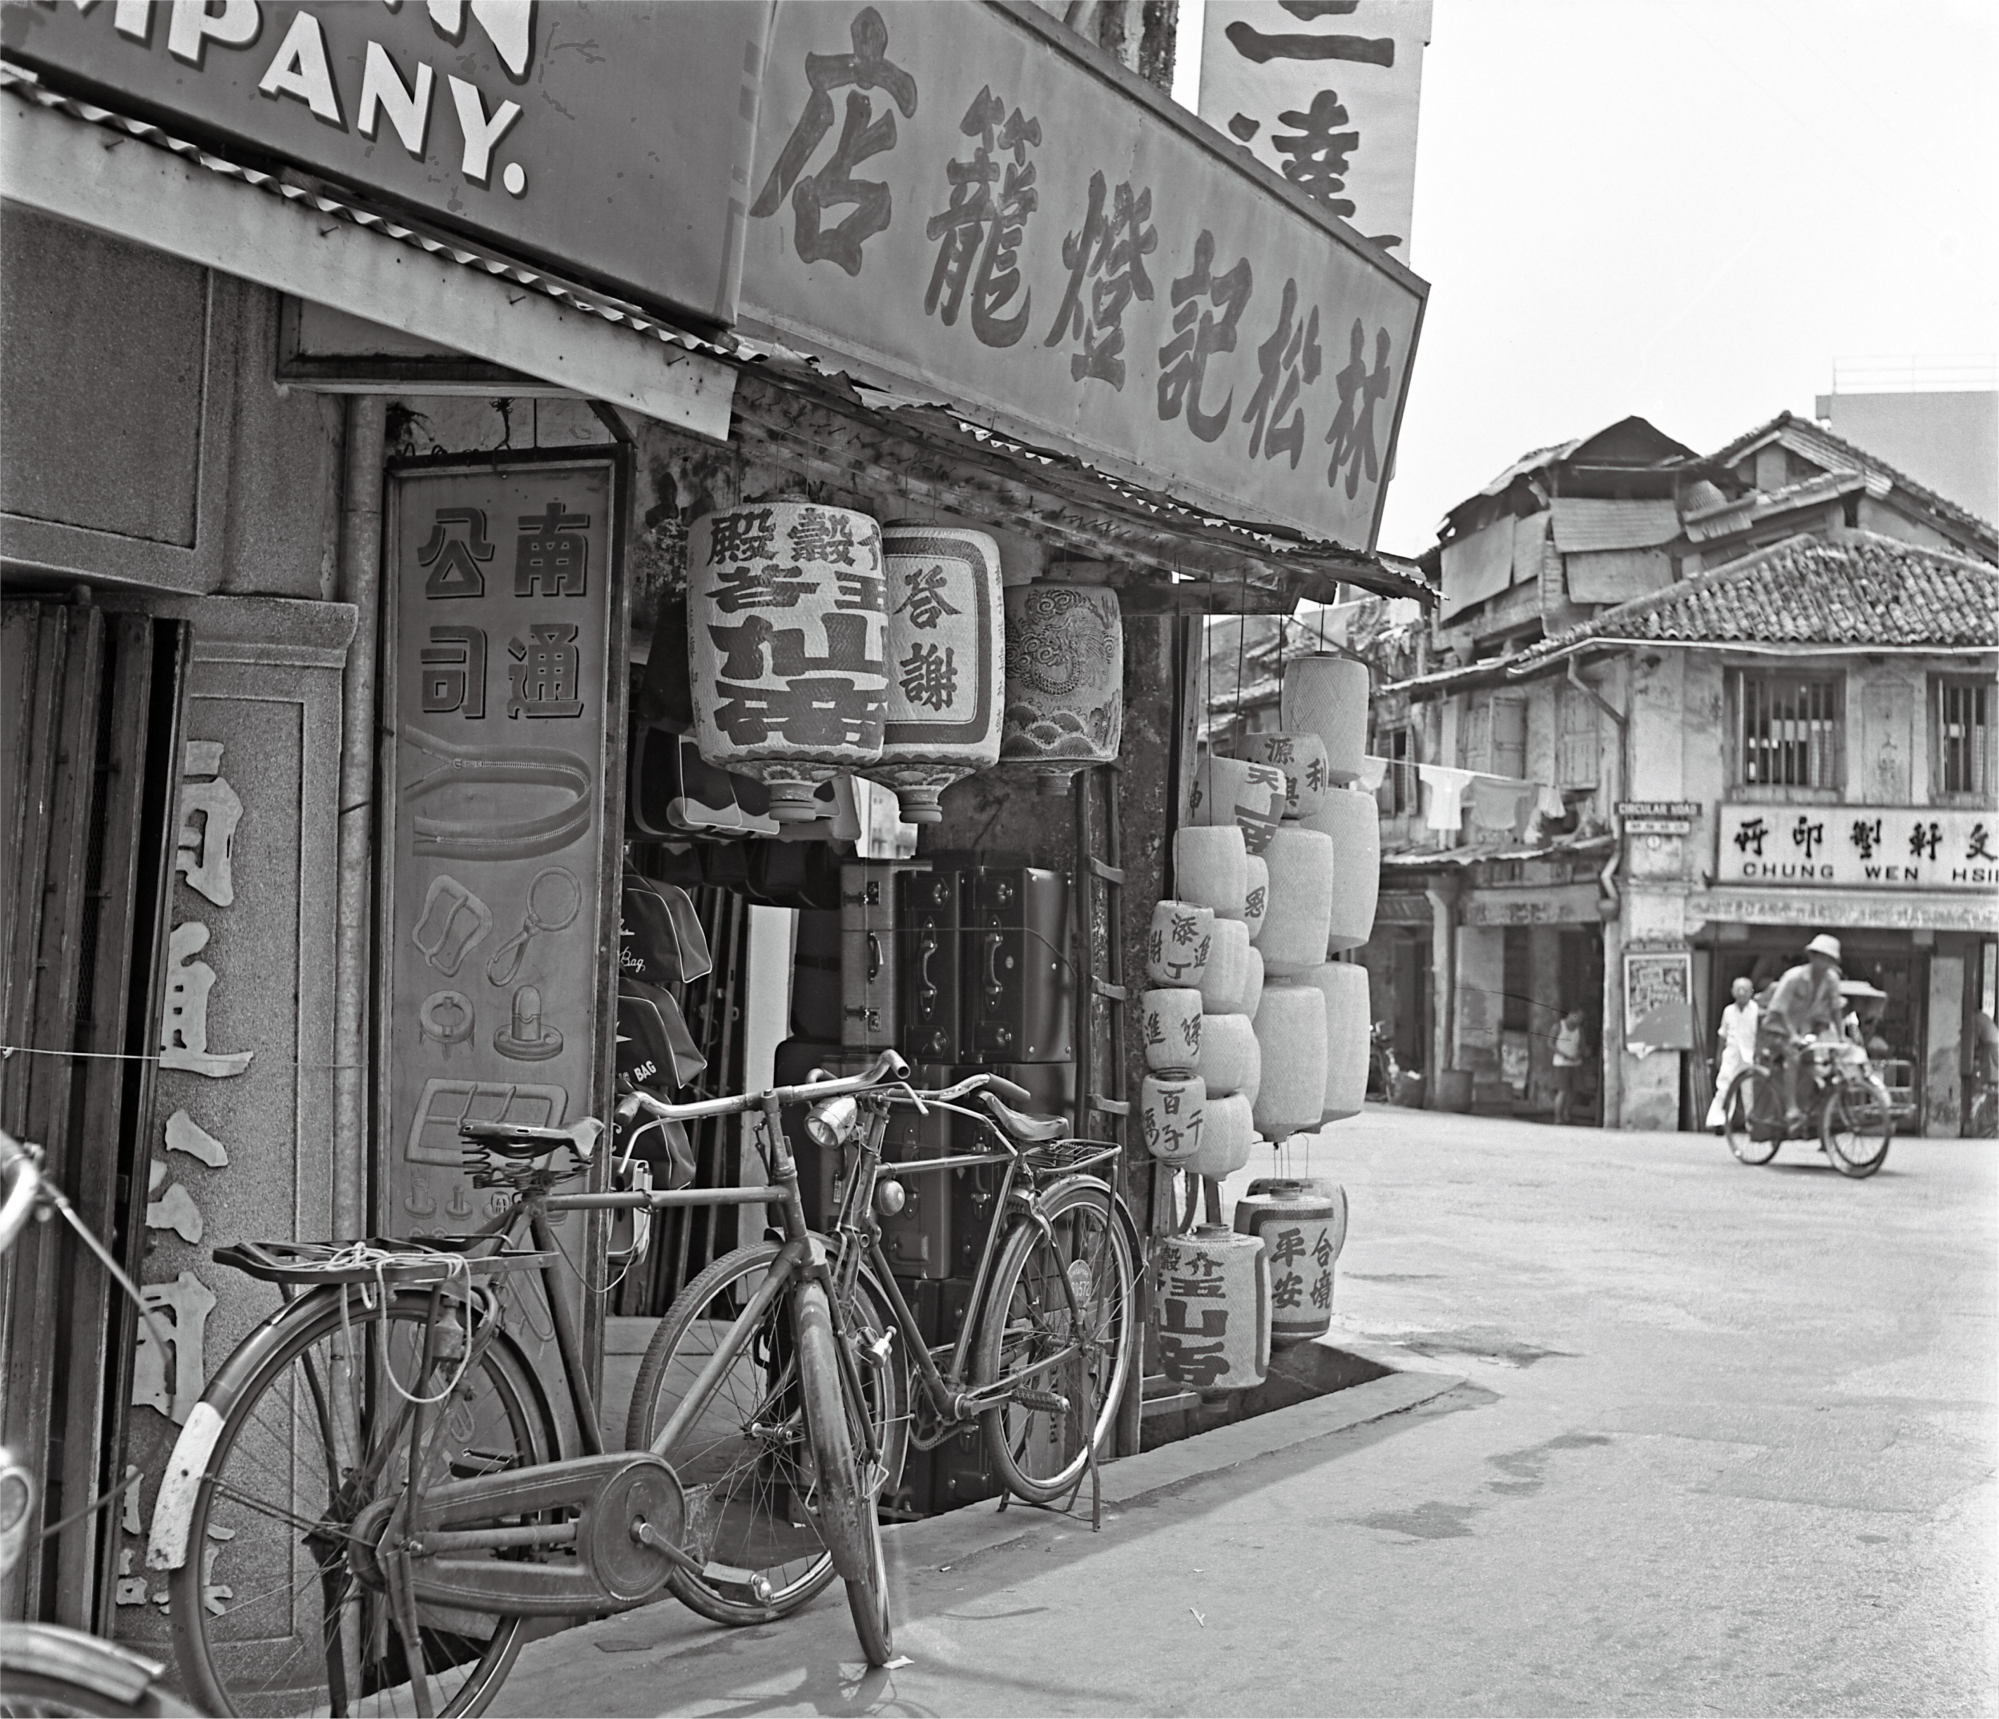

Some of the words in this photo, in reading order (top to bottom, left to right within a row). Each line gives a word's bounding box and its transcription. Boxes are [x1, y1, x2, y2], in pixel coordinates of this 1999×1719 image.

[749, 6, 1391, 500] 林松記燈籠店
[417, 506, 495, 719] 公司
[507, 502, 590, 719] 南通
[894, 565, 963, 712] 答謝
[1618, 803, 1668, 815] CIRCULAR
[1670, 804, 1698, 816] ROAD
[1743, 862, 1834, 880] CHUNG
[1864, 865, 1920, 882] WEN
[633, 1060, 657, 1082] BAG
[1270, 1227, 1307, 1309] 平安
